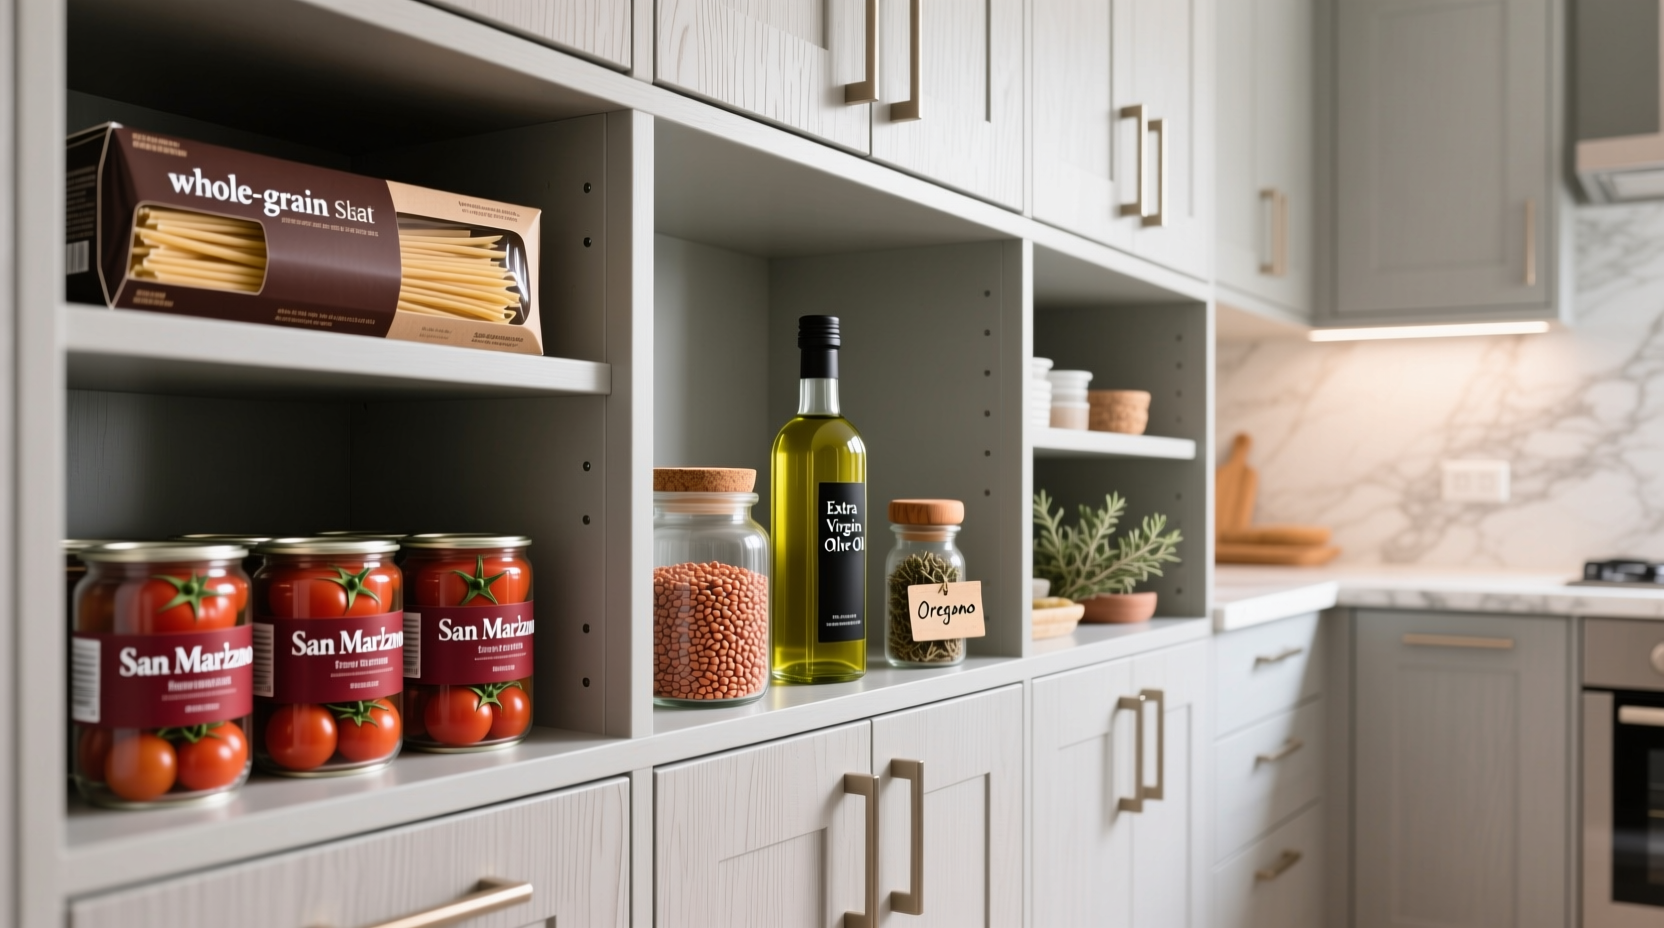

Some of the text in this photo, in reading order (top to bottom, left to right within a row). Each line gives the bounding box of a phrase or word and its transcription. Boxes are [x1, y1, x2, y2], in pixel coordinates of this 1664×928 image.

[168, 168, 330, 217] whole-grain
[826, 500, 858, 515] Extra
[438, 618, 478, 641] San
[291, 630, 336, 656] San
[119, 647, 171, 677] San
